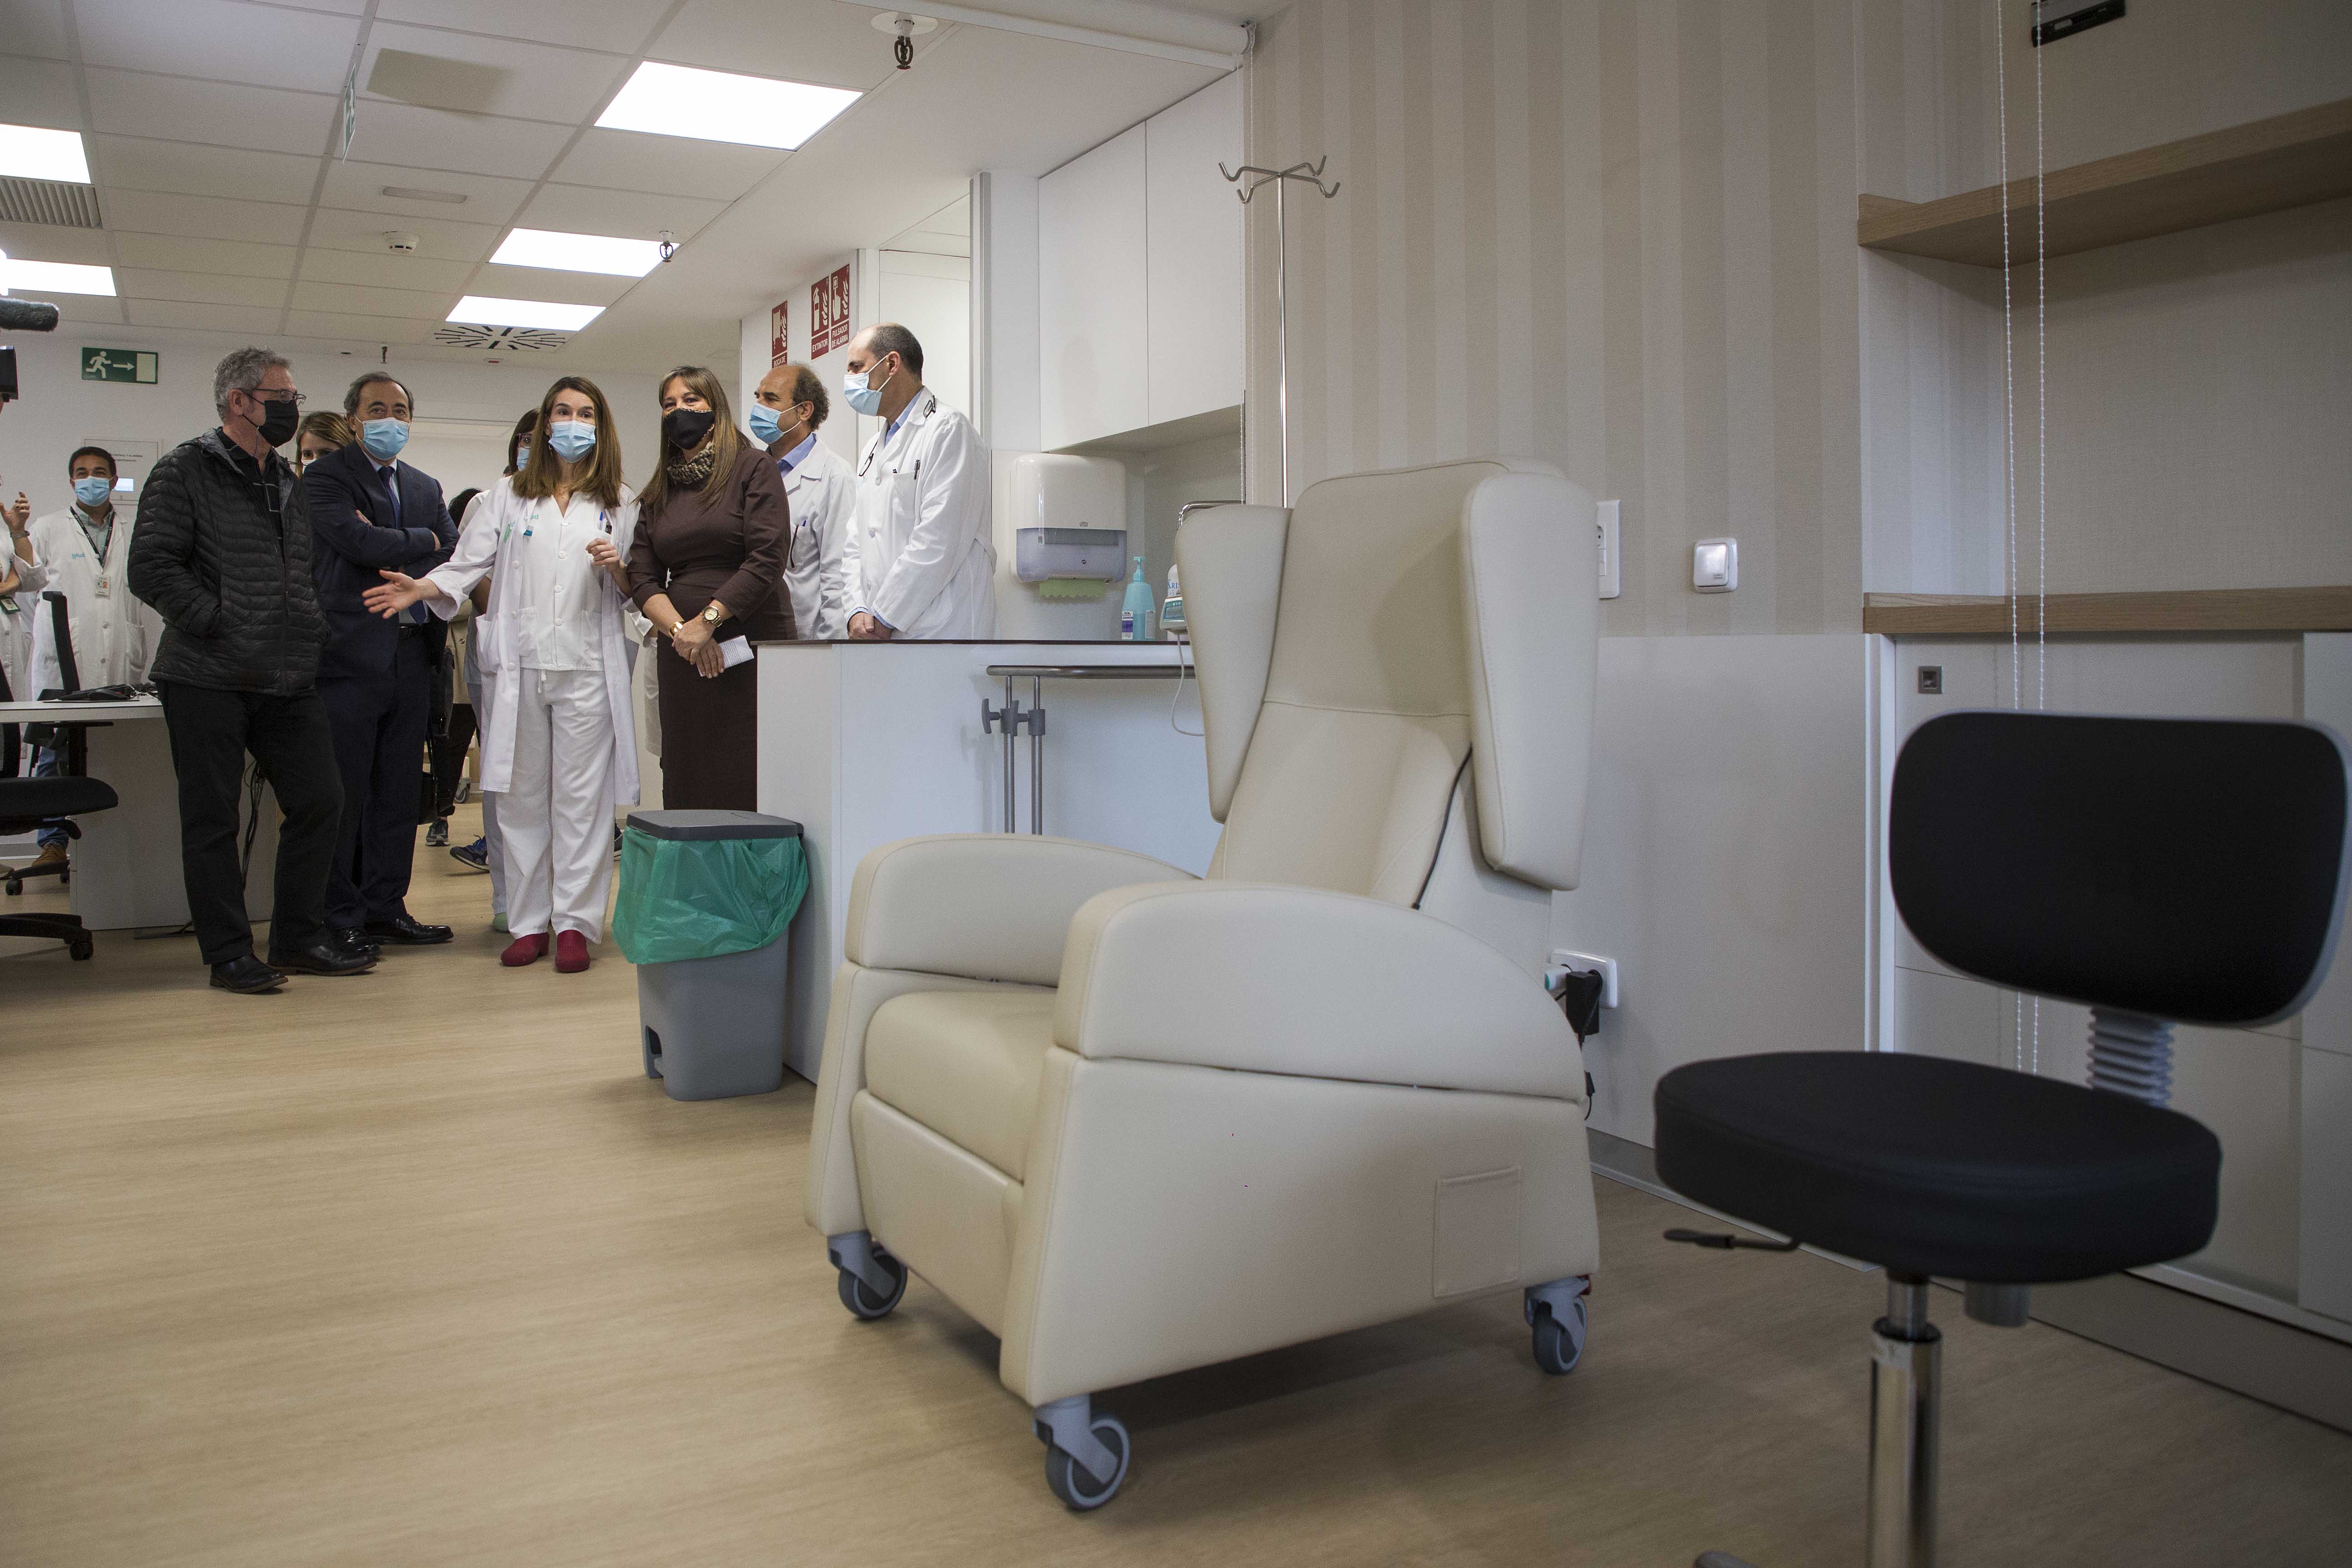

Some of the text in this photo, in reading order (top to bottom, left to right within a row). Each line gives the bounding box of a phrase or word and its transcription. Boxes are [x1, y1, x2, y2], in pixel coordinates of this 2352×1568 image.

[832, 324, 848, 338] PULSADOR
[812, 338, 828, 352] EXTINTOR
[832, 334, 849, 347] DE ALARMA
